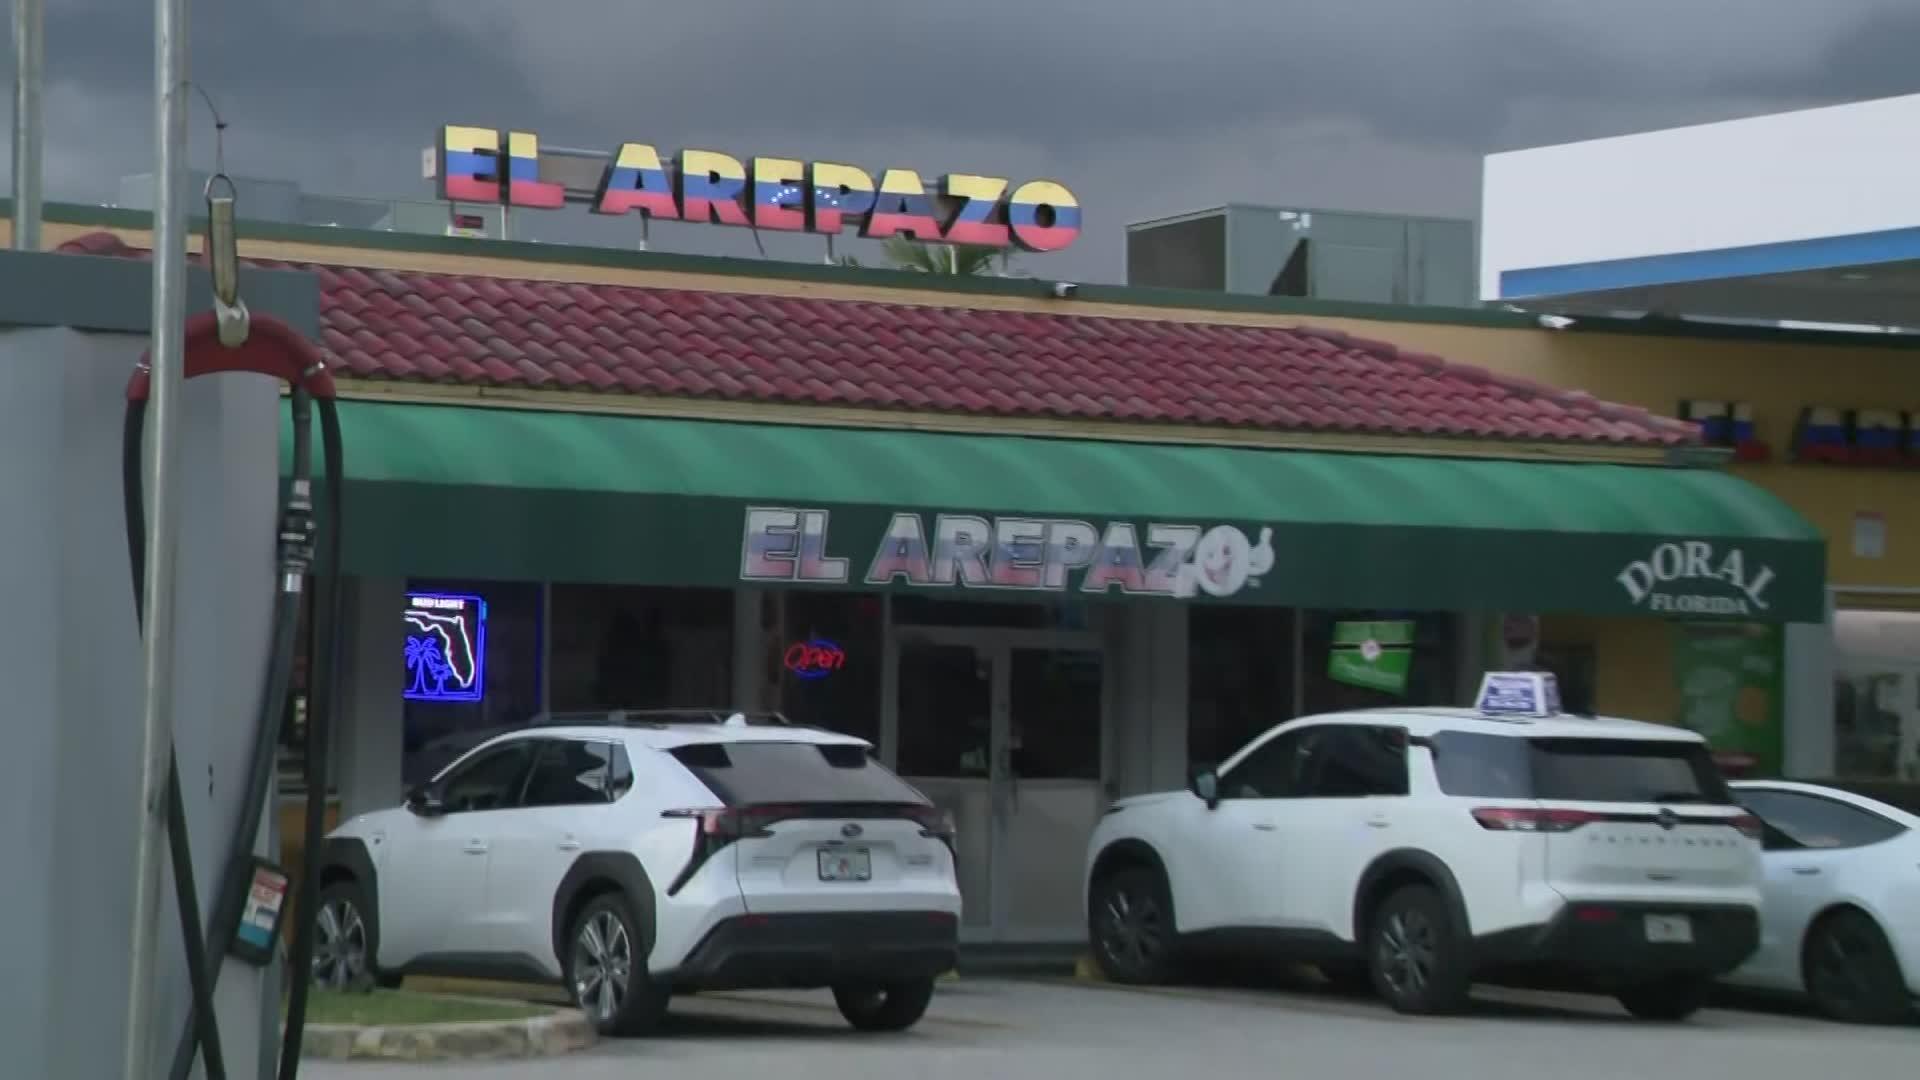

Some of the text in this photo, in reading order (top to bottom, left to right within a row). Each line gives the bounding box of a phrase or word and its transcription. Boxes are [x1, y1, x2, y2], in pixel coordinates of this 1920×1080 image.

[442, 124, 1082, 253] EL AREPAZO
[740, 506, 1250, 598] EL AREPAZO
[1616, 540, 1775, 609] DORAL
[412, 597, 464, 609] BUD LIGHT
[1650, 592, 1749, 615] FLORIDA
